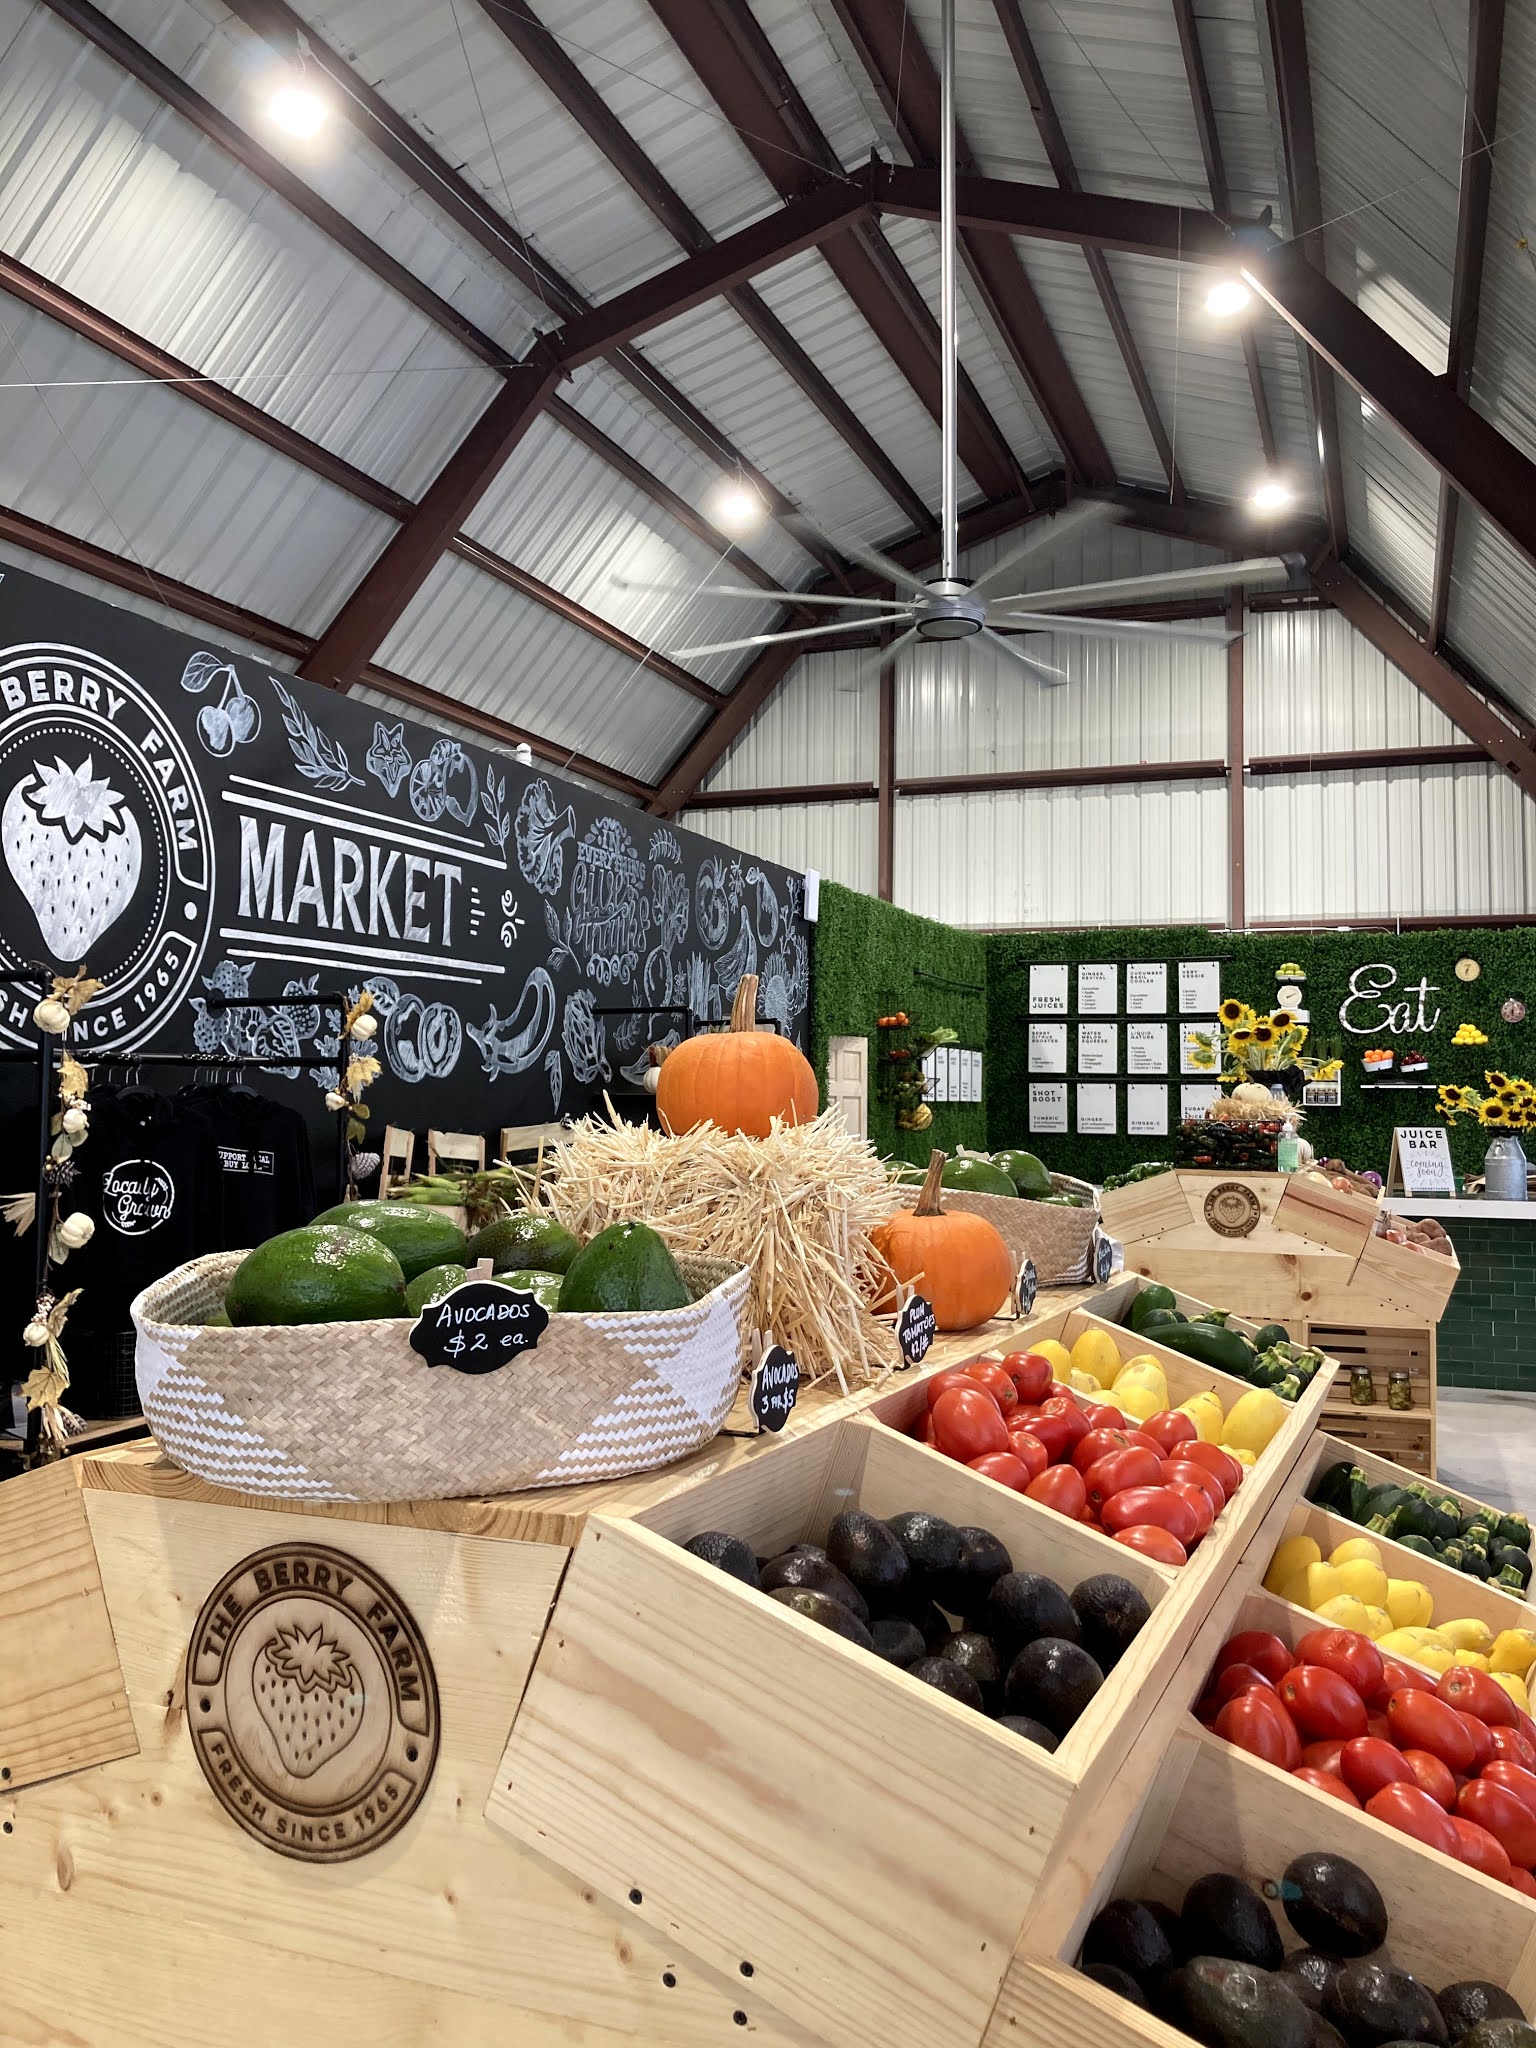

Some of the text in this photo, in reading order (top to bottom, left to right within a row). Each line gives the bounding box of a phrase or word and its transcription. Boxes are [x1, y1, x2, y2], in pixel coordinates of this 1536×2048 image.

[0, 669, 197, 851] BERRY FARM
[602, 829, 621, 854] IN
[577, 841, 646, 882] EVERYTHING
[237, 814, 463, 947] MARKET
[134, 950, 180, 1006] 1965
[1339, 963, 1441, 1034] Eat
[1400, 1130, 1442, 1139] JUICE
[1409, 1140, 1437, 1149] BAR
[223, 1160, 238, 1168] BUY
[435, 1303, 531, 1328] AVOCADOS
[902, 1314, 935, 1344] TOMATOES
[443, 1329, 488, 1358] $2
[762, 1362, 798, 1391] AVOCADOS
[202, 1561, 421, 1702] THE BERRY FARM
[211, 1743, 398, 1842] FRESH SINCE 1965
